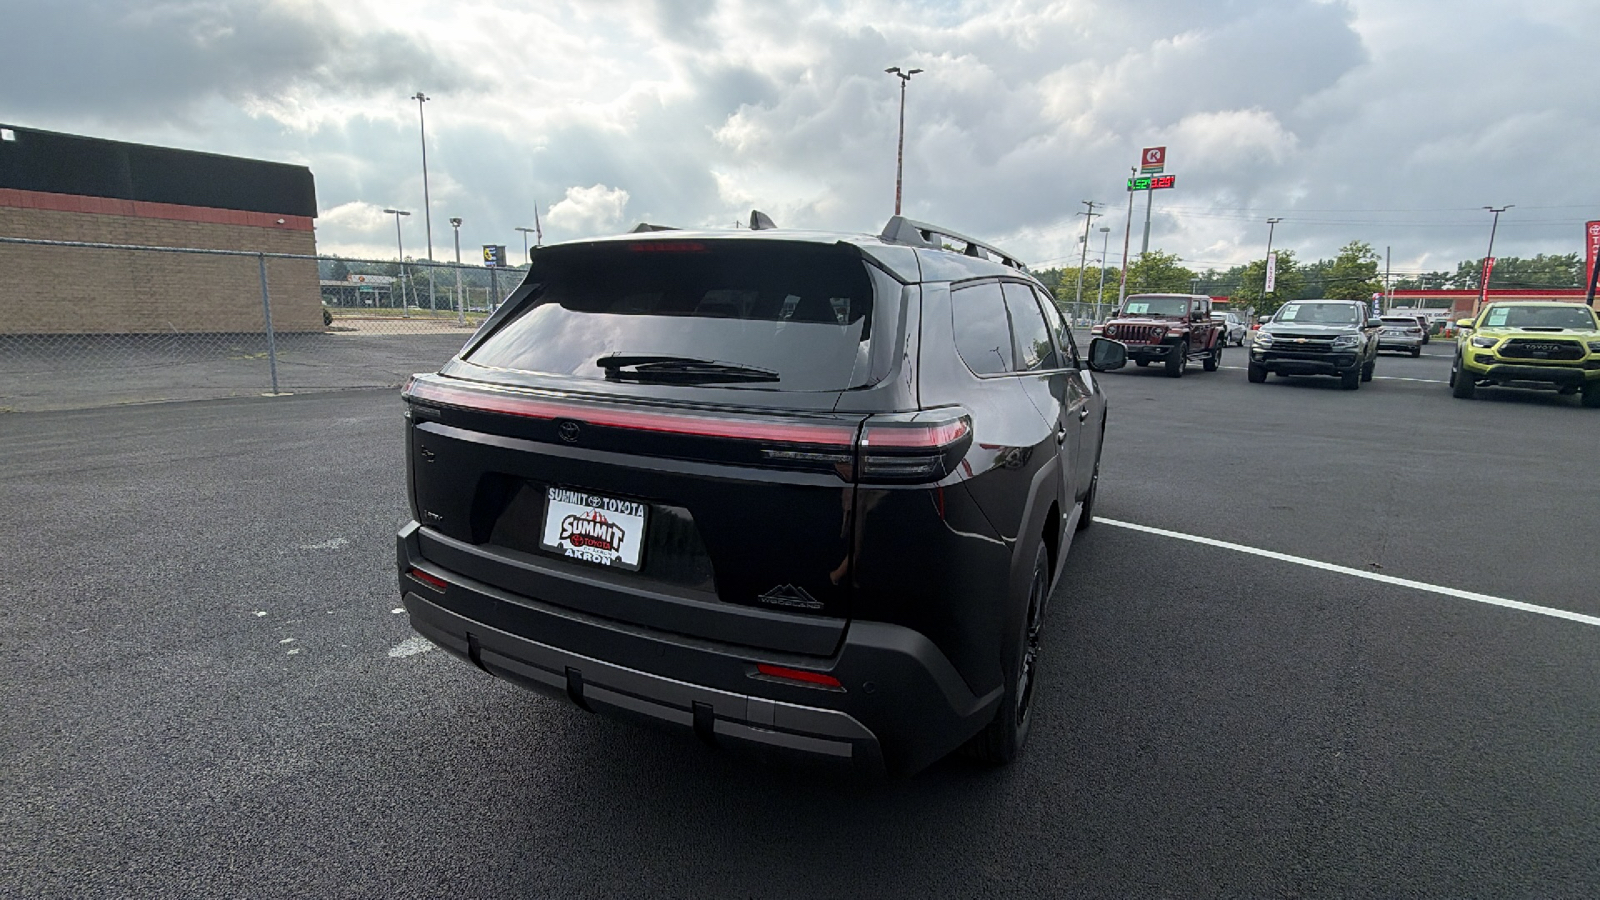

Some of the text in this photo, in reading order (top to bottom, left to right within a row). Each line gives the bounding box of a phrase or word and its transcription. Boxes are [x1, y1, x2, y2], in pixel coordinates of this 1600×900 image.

[548, 487, 644, 517] SUMMIT TOYOTA
[562, 517, 623, 549] SUMMIT
[584, 537, 611, 550] TOYOTA
[564, 548, 611, 566] AKRON
